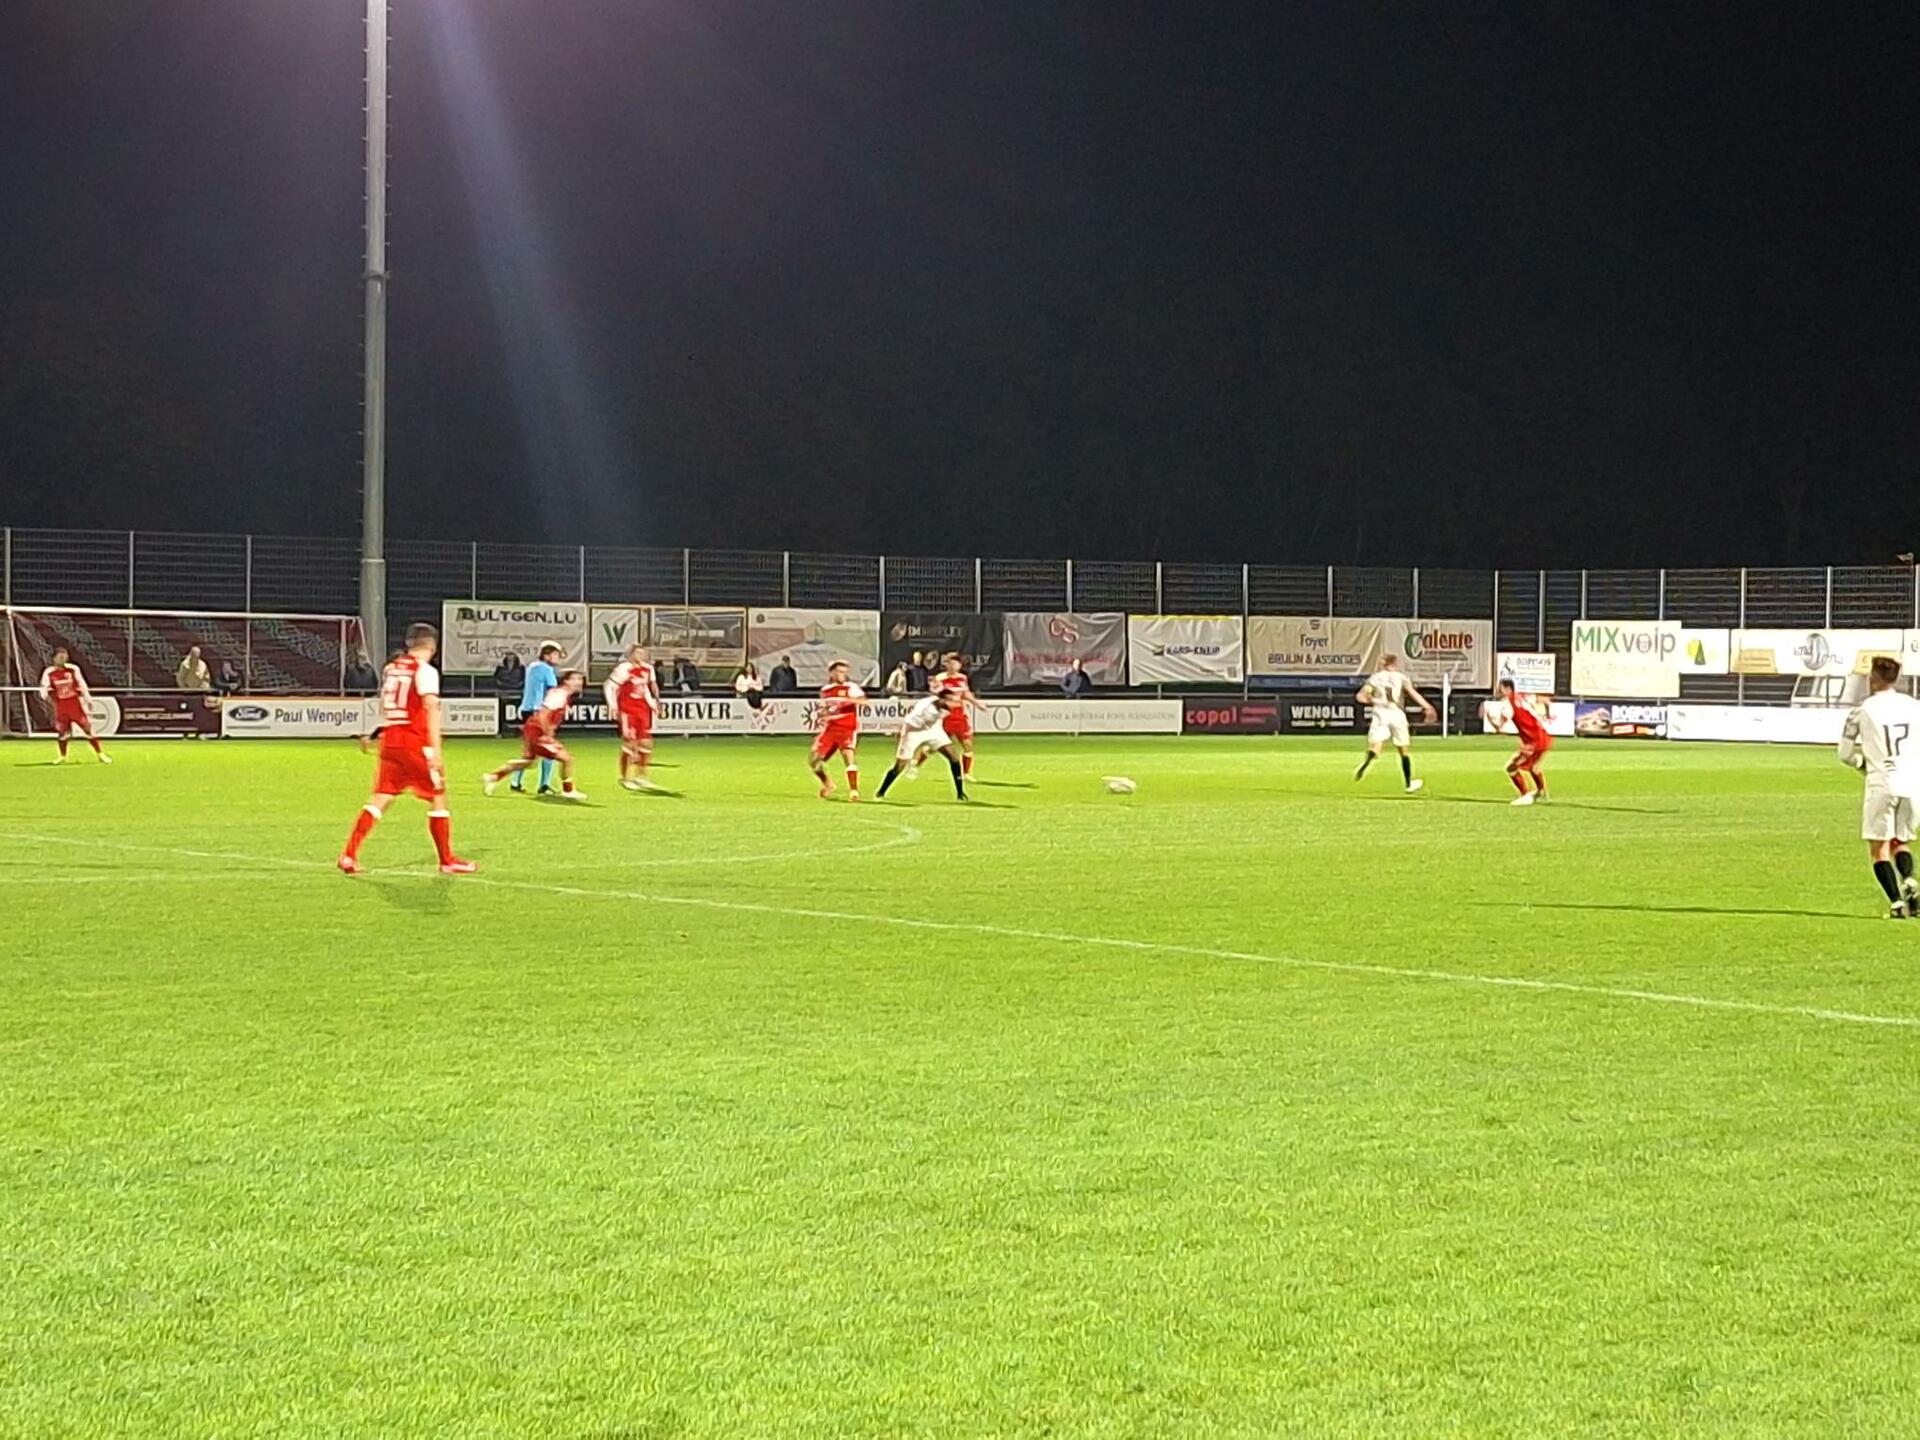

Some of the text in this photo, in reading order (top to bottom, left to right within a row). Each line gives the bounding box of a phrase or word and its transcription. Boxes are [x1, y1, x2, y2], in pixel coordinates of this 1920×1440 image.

[1575, 626, 1676, 662] MIXvoip
[275, 708, 303, 722] Paul
[307, 708, 359, 725] Wengler
[658, 702, 730, 719] BREVER
[1186, 706, 1238, 725] copal
[1291, 706, 1354, 718] WENGLER
[1883, 723, 1909, 757] 17
